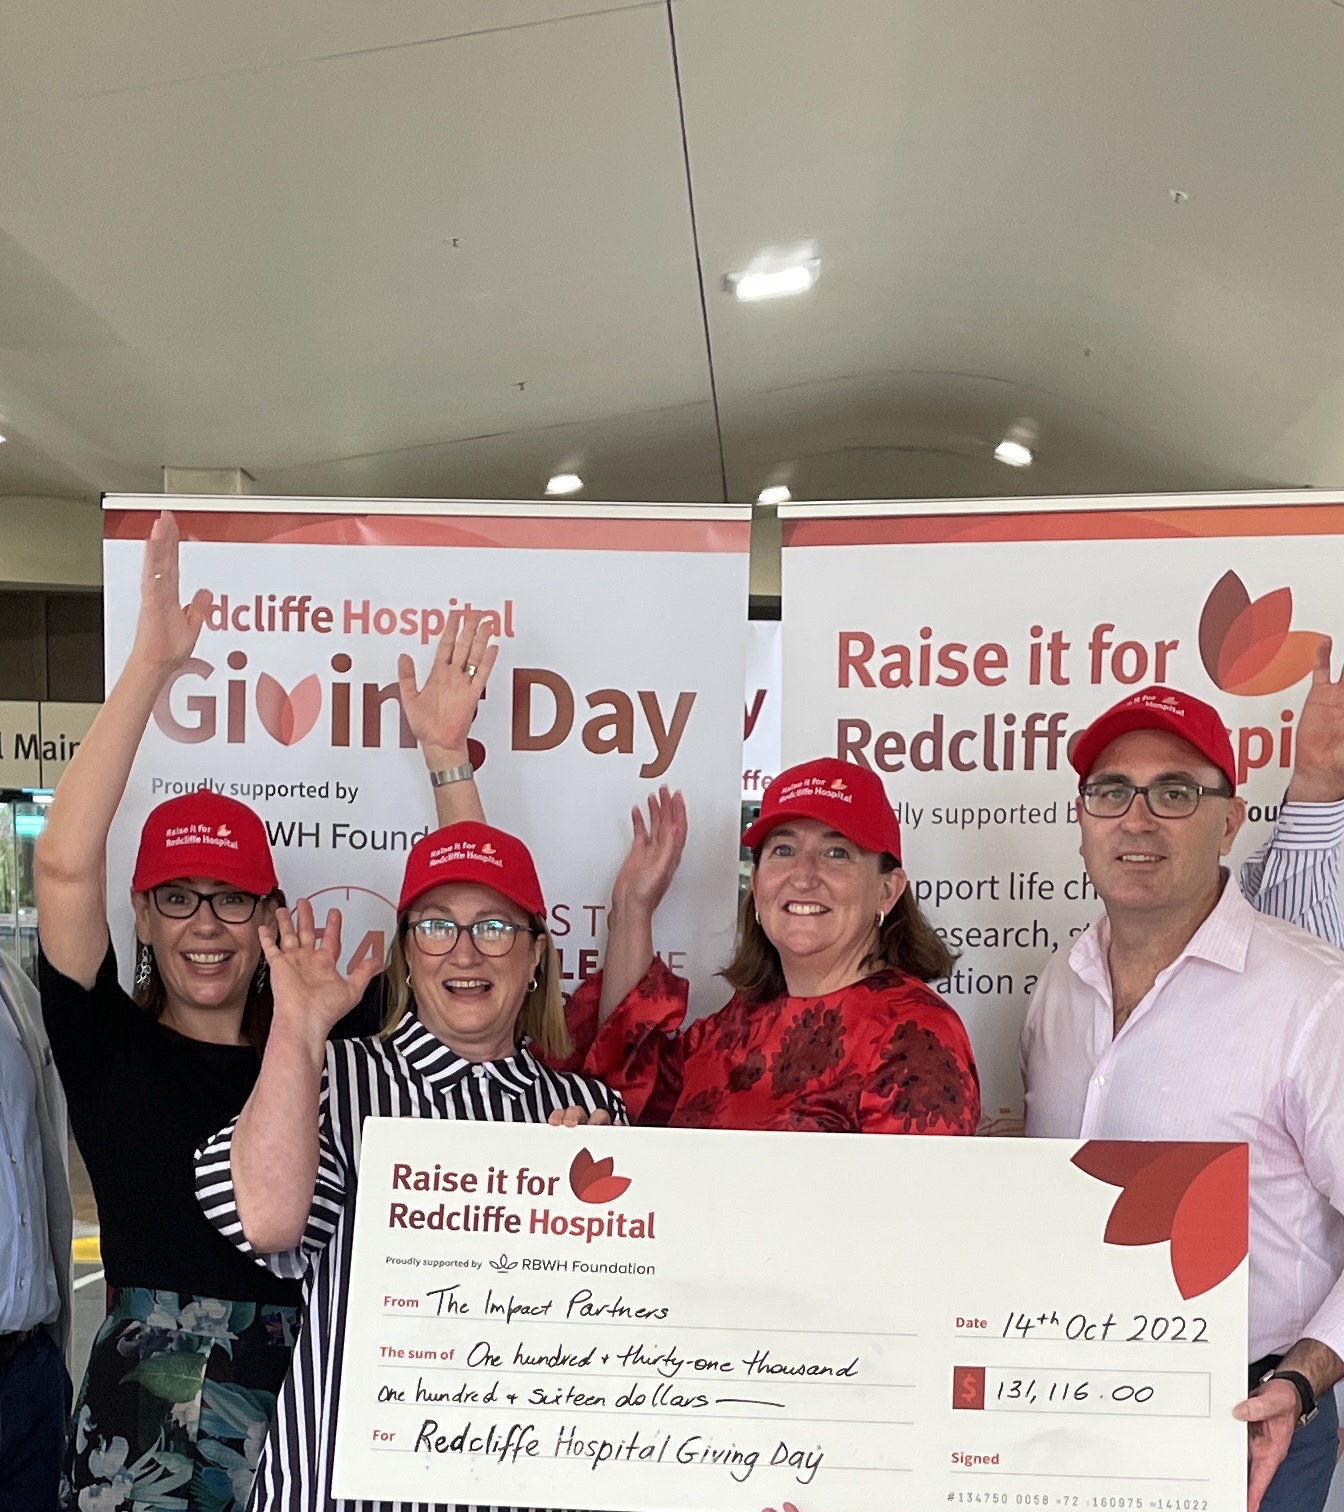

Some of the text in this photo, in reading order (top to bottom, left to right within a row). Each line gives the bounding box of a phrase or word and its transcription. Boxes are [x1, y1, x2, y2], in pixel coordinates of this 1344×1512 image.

[183, 594, 334, 632] dcliffe
[838, 623, 1180, 689] Raise it for
[511, 668, 698, 779] Day
[230, 781, 330, 801] supported
[335, 782, 359, 804] by
[931, 801, 1057, 830] supported
[265, 821, 320, 848] WH
[907, 875, 1000, 907] pport
[1009, 871, 1054, 901] life
[935, 919, 1058, 953] esearch,
[936, 968, 1013, 995] ation
[392, 1163, 561, 1197] Raise it for
[389, 1202, 656, 1244] Redcliffe Hospital
[385, 1256, 482, 1270] Proudly supported by
[522, 1259, 656, 1275] RBWH Foundation
[383, 1296, 419, 1309] From
[426, 1284, 670, 1325] The Impact Partners
[956, 1317, 988, 1329] Date
[1066, 1313, 1117, 1341] Oct
[1126, 1315, 1209, 1343] 2022
[379, 1346, 455, 1361] The sum of
[467, 1341, 504, 1368] One
[513, 1342, 597, 1368] hundred
[617, 1344, 735, 1378] thirty-one
[742, 1350, 859, 1377] thousand
[416, 1377, 499, 1402] hundred
[615, 1382, 709, 1408] dollars
[961, 1373, 977, 1402] $
[373, 1430, 396, 1442] For
[414, 1419, 824, 1484] Redcliffe Hospital Giving Day
[951, 1452, 1000, 1468] Signed
